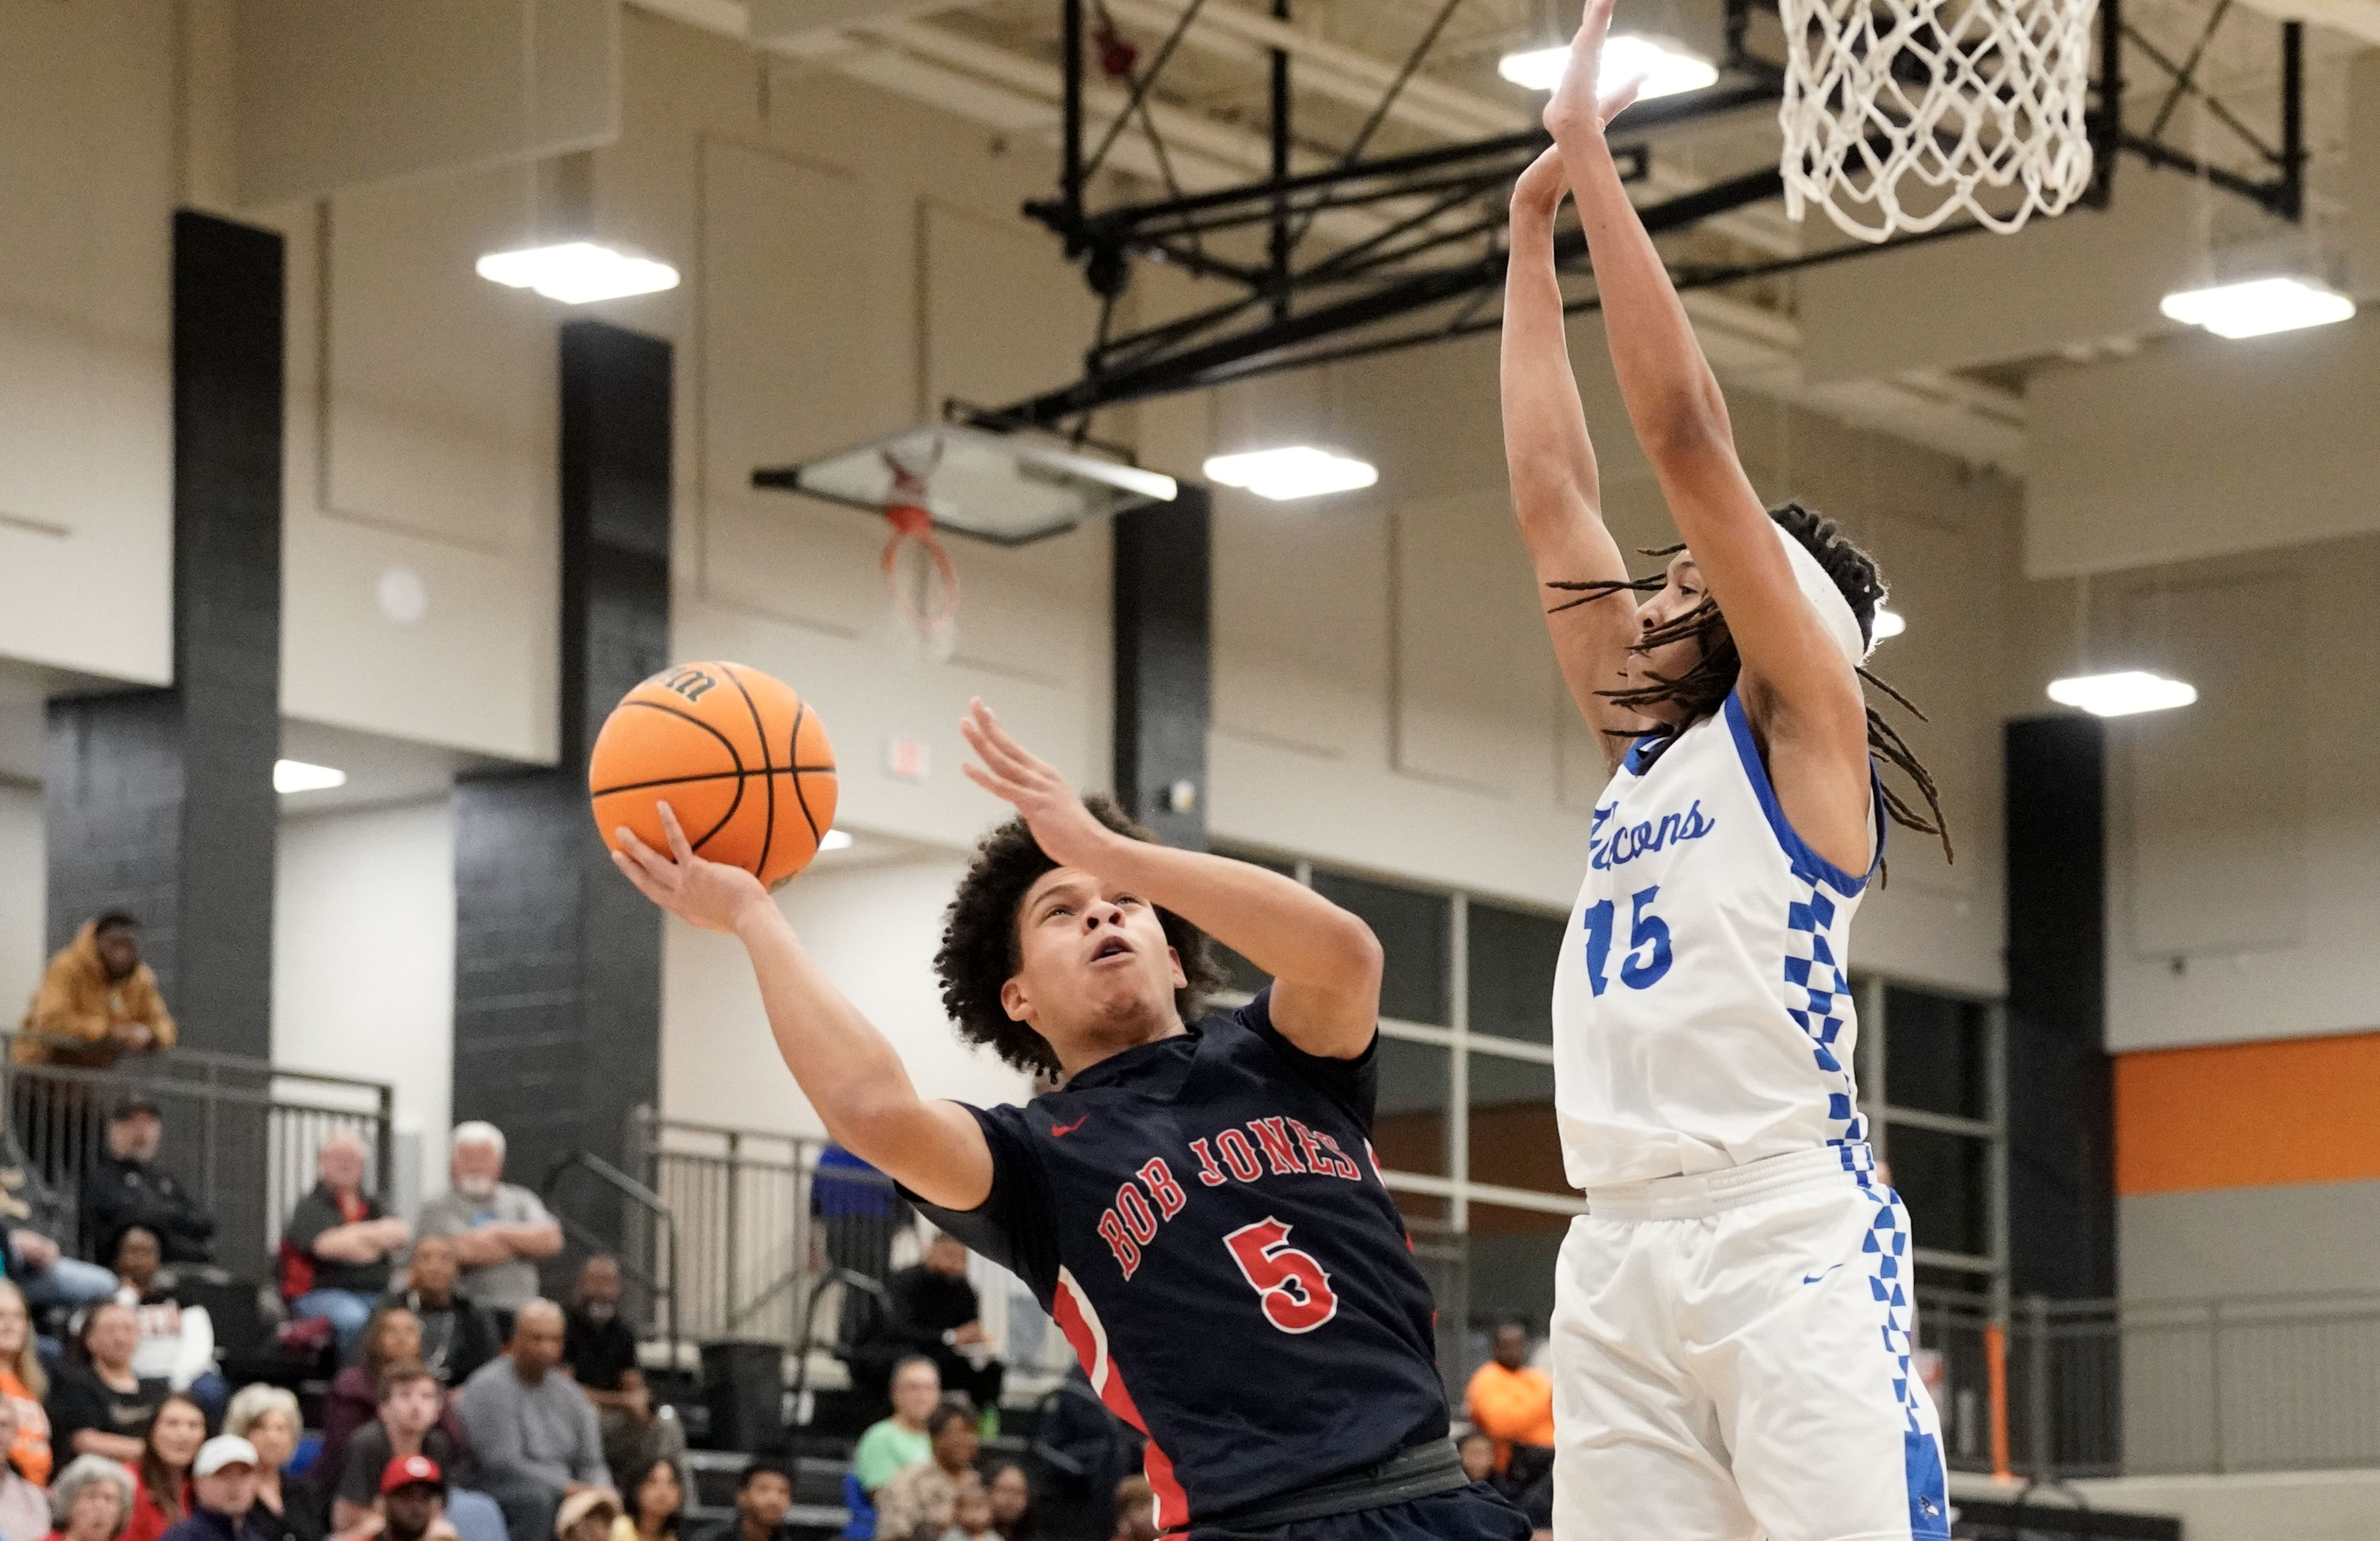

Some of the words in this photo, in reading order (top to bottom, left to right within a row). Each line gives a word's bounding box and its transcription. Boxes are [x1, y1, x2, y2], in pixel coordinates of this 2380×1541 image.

[1588, 800, 1715, 870] Fcons
[1584, 885, 1672, 997] 15
[1097, 1157, 1187, 1281] BOB
[1189, 1115, 1362, 1187] JONES
[1222, 1215, 1338, 1334] 5
